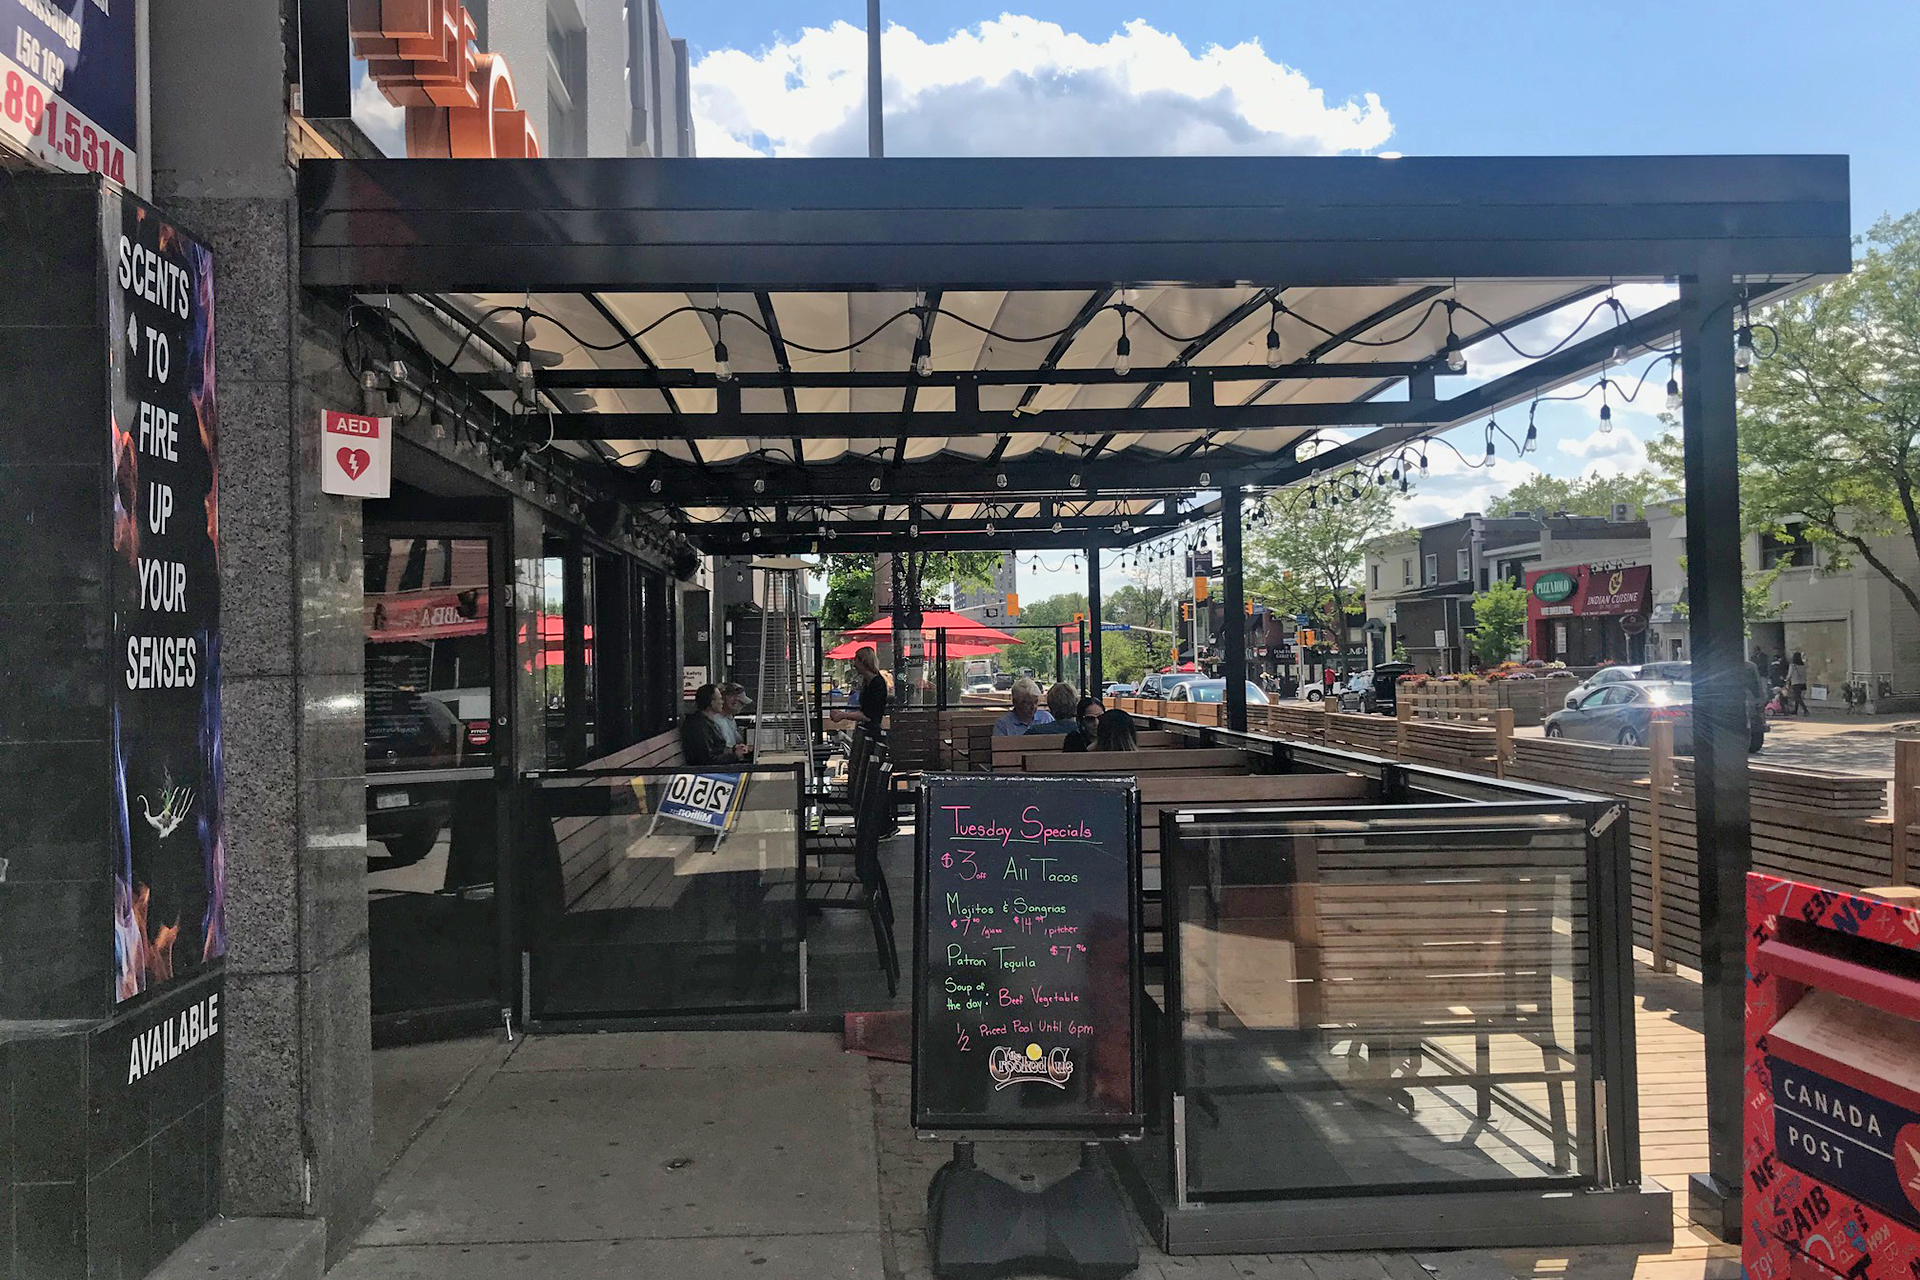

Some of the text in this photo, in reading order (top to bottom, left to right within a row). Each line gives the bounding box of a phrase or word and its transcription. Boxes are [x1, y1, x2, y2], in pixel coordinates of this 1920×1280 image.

[16, 26, 65, 92] L5G 1C9
[119, 235, 189, 320] SCENTS
[146, 327, 169, 384] TO
[139, 401, 178, 463] FIRE
[336, 417, 371, 435] AED
[149, 482, 173, 535] UP
[138, 556, 187, 612] YOUR
[1587, 592, 1638, 606] INDIAN CUISINE
[126, 636, 196, 690] SENSES
[941, 805, 1092, 847] Tuesday Specials
[1003, 857, 1028, 881] All
[1030, 858, 1079, 883] Tacos
[946, 892, 994, 920] Mojitos
[1013, 897, 1067, 919] Sangrias
[947, 943, 987, 966] Patron
[992, 946, 1036, 973] Tequila
[945, 977, 985, 995] Soup of
[946, 999, 961, 1011] the
[999, 988, 1024, 1007] Beef
[1031, 986, 1079, 1008] Vegetable
[128, 993, 219, 1085] AVAILABLE
[1012, 1019, 1033, 1033] Pool
[1039, 1020, 1062, 1033] Until
[1068, 1019, 1094, 1038] 6pm
[989, 1045, 1047, 1083] Crooked
[1783, 1078, 1883, 1138] CANADA
[1788, 1125, 1846, 1169] POST
